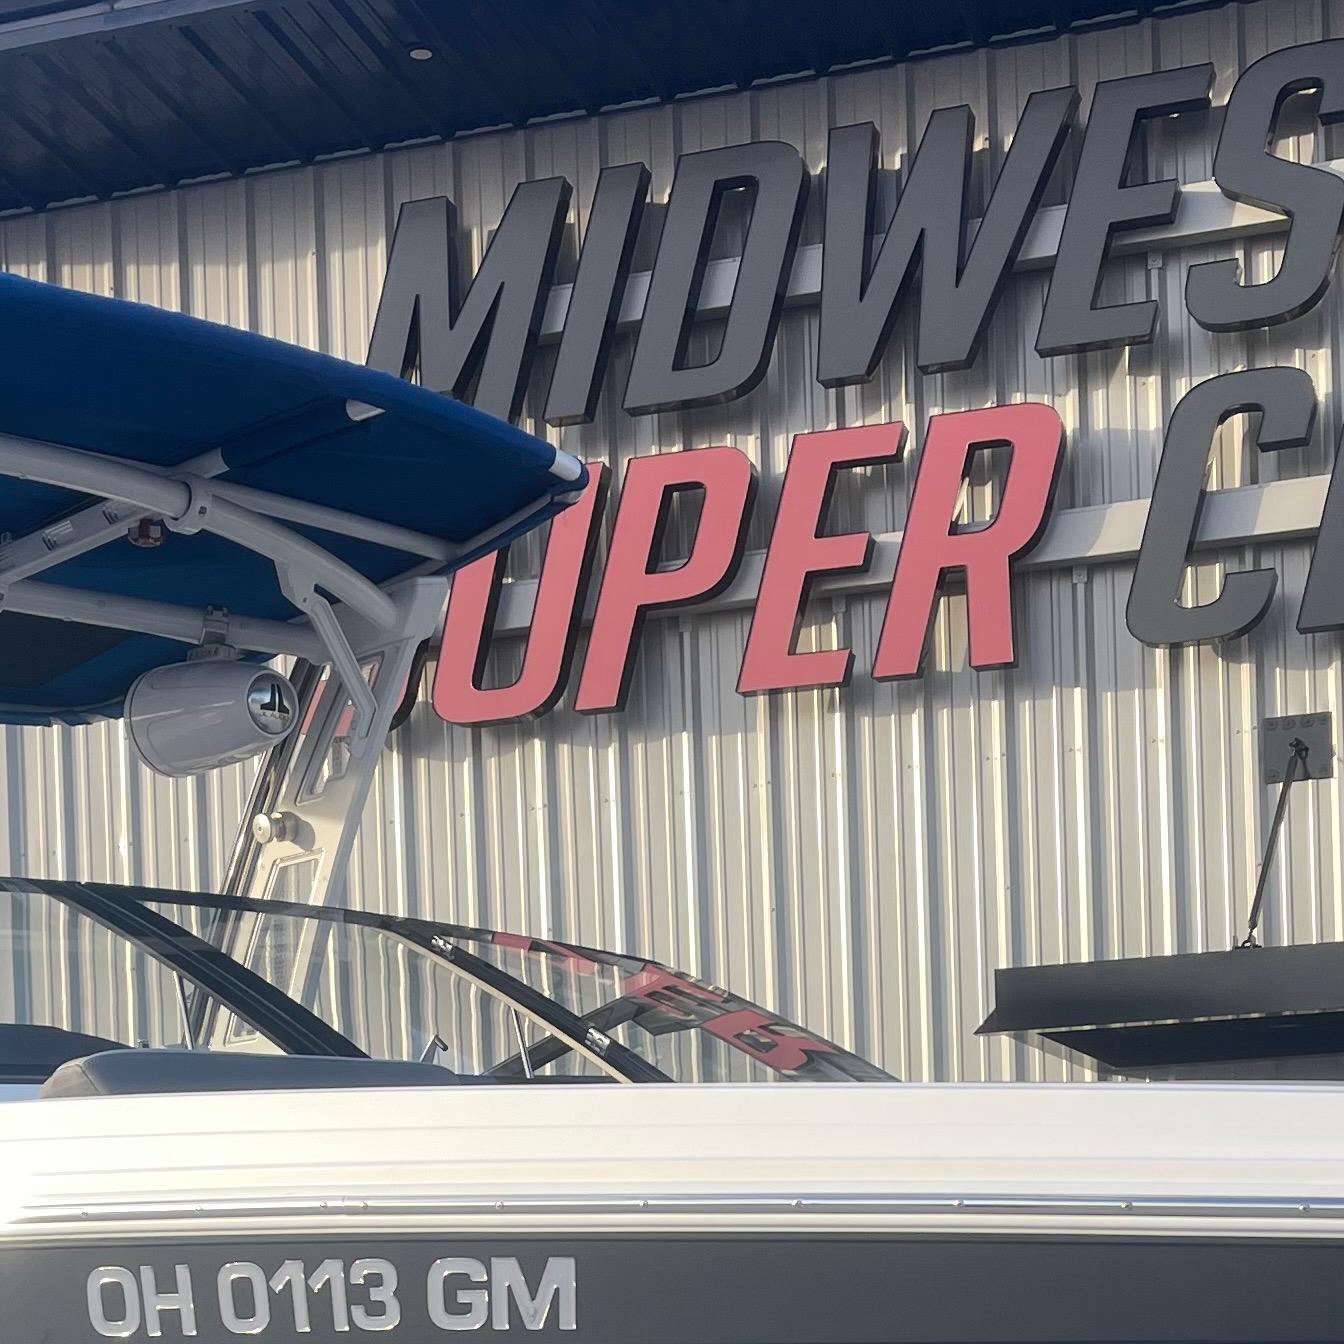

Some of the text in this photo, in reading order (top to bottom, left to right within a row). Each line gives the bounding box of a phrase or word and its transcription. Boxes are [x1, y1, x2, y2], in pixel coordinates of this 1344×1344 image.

[301, 401, 1064, 733] UPER
[86, 1256, 577, 1338] OH 0113 GM
